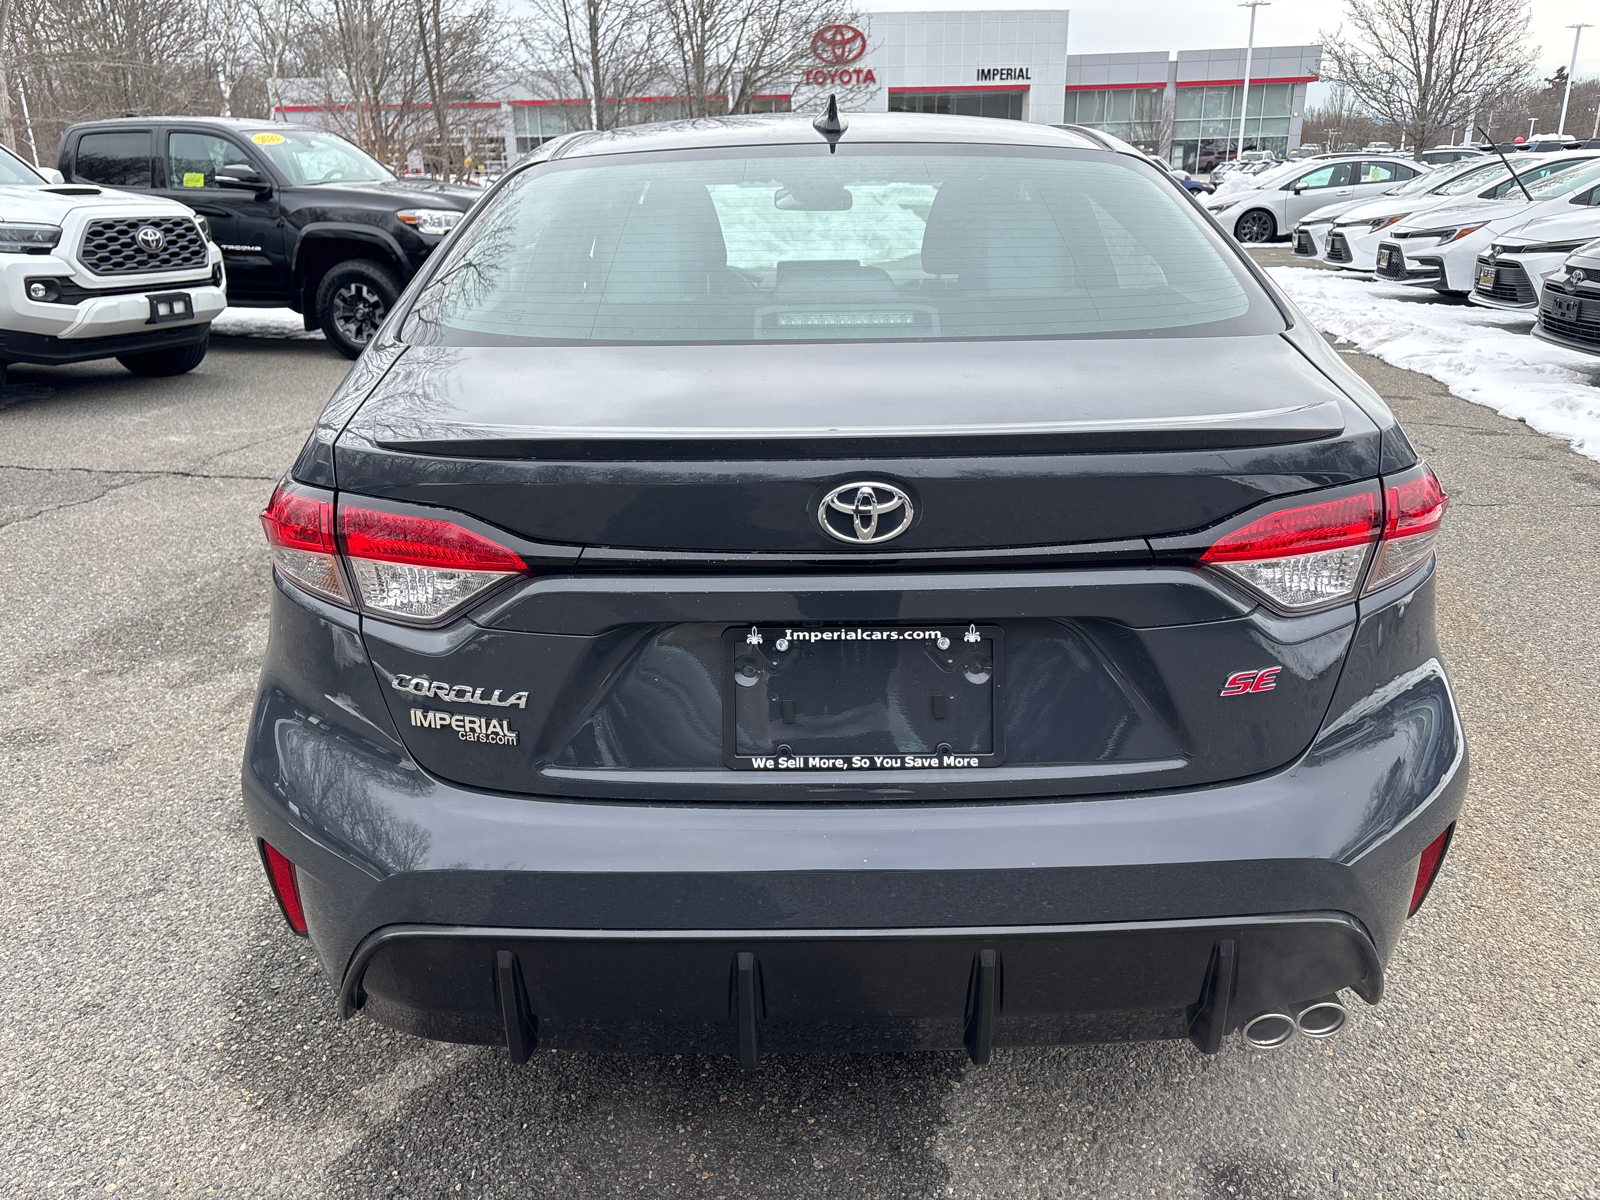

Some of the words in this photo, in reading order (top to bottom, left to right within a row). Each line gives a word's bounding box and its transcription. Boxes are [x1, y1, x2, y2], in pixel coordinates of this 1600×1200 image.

[804, 68, 877, 86] TOYOTA
[976, 67, 1032, 82] IMPERIAL
[785, 629, 942, 643] Imperialcars.com
[1220, 665, 1283, 697] SE
[391, 673, 530, 709] COROLLA
[410, 708, 519, 738] IMPERIAL
[458, 730, 518, 746] cars.com
[751, 757, 775, 769] We
[778, 756, 804, 769] Sell
[808, 757, 848, 770] More,
[851, 756, 870, 769] So
[874, 756, 901, 768] You
[904, 756, 940, 768] Save
[943, 755, 980, 767] More
